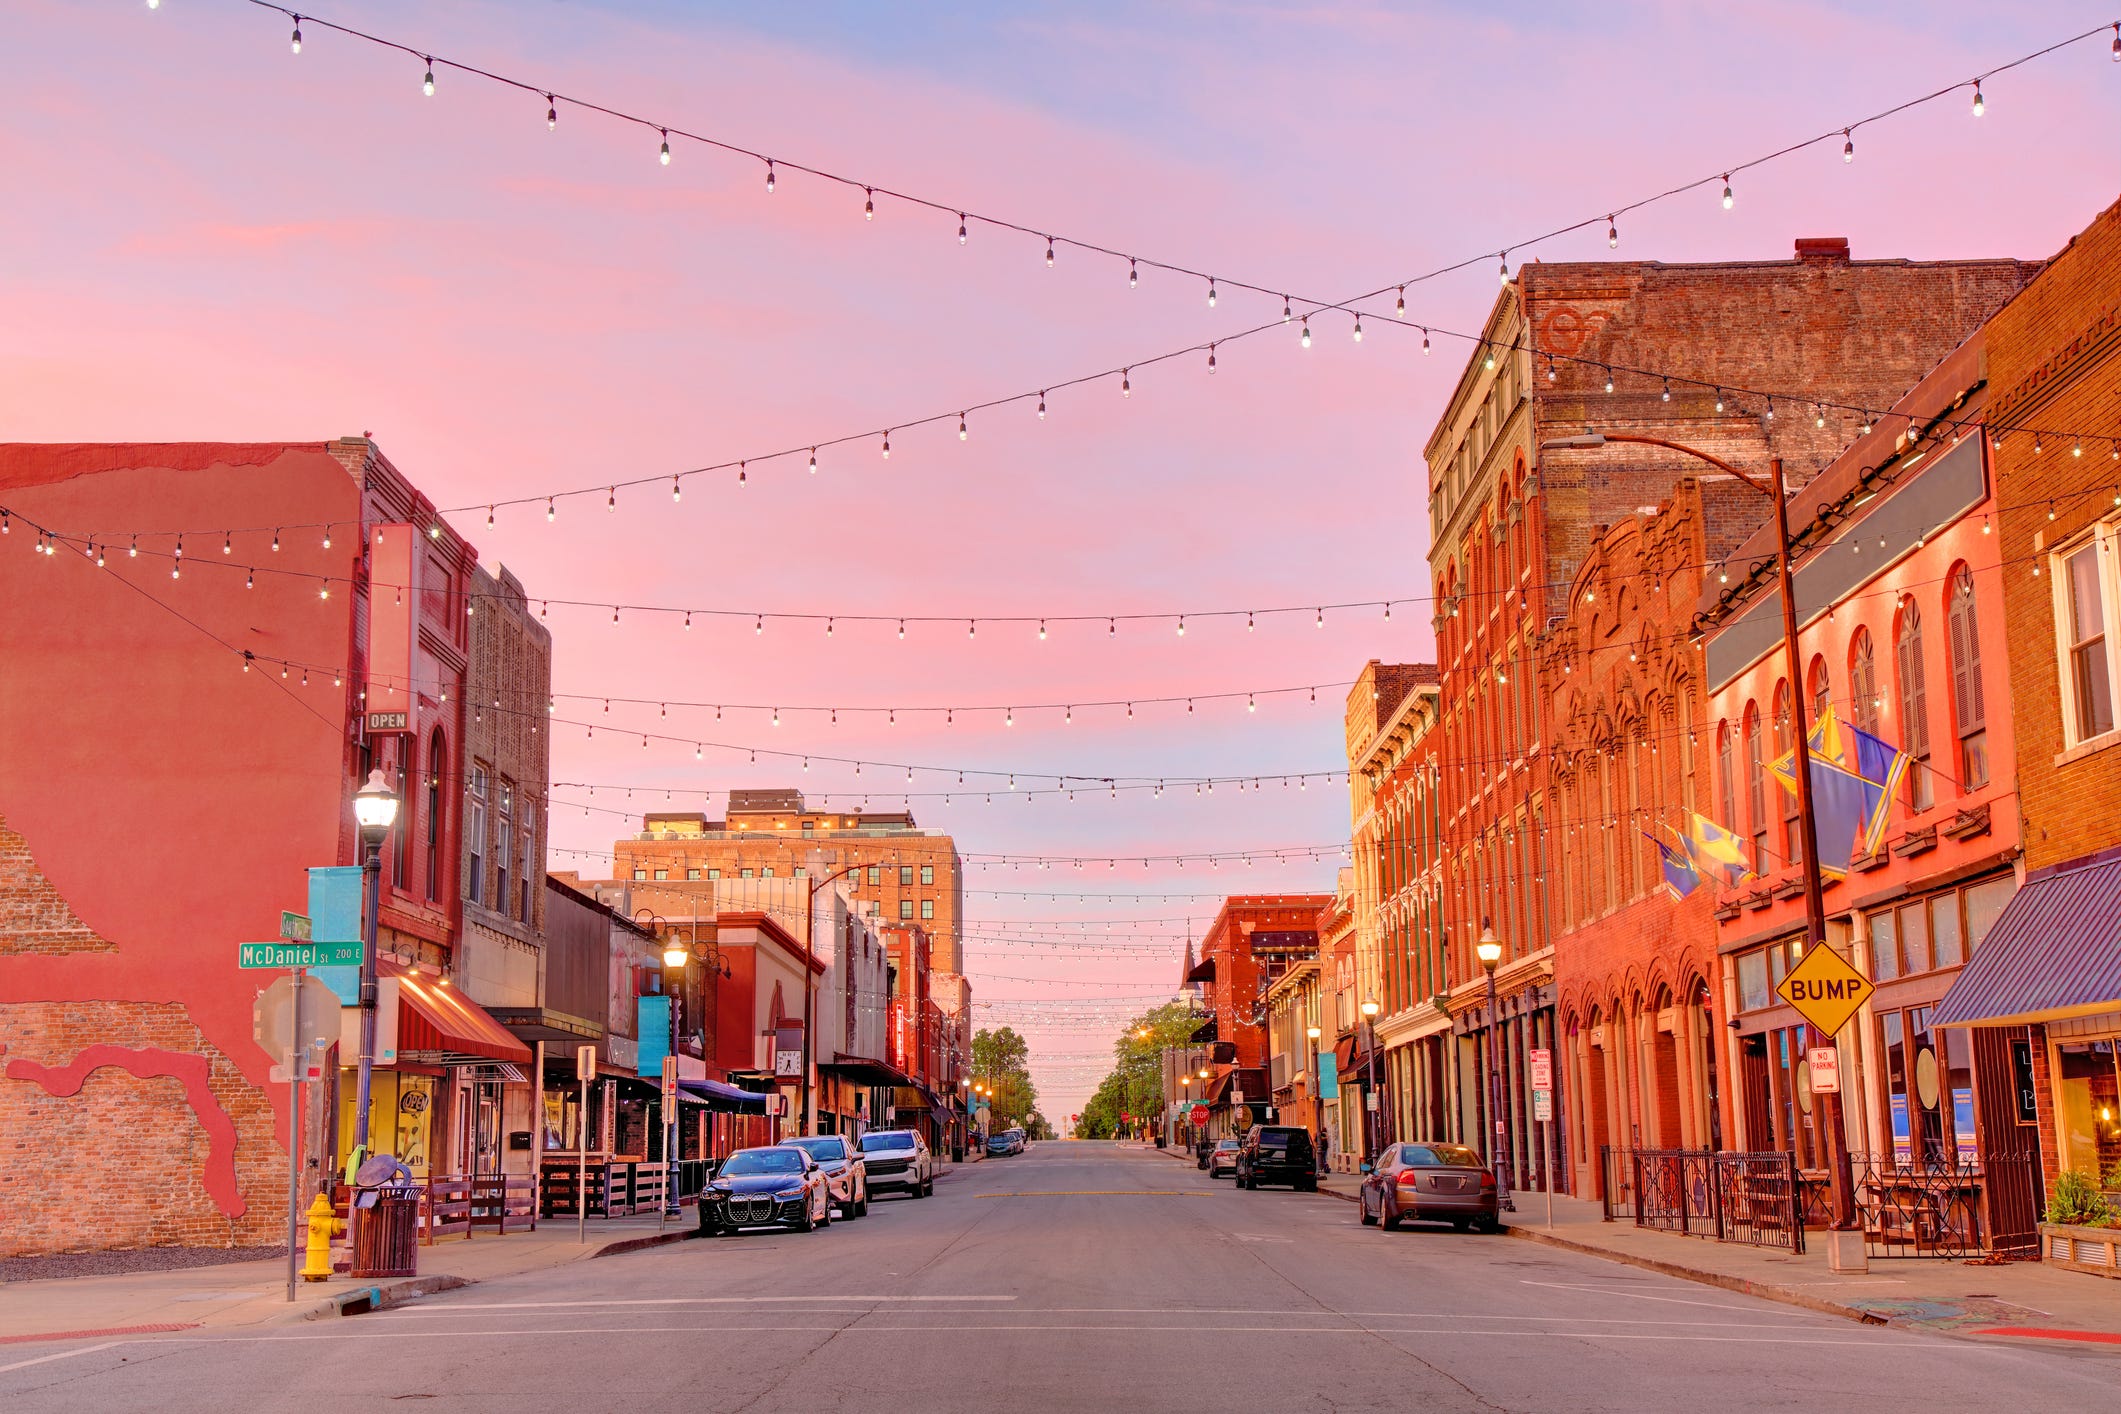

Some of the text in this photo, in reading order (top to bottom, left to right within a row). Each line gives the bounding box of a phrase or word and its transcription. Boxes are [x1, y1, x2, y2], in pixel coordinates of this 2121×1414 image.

[370, 714, 405, 728] OPEN
[243, 946, 360, 965] McDaniel St 200 E
[1790, 979, 1862, 1001] BUMP
[1817, 1052, 1828, 1061] NO
[1812, 1062, 1836, 1070] PARKING
[404, 1094, 428, 1110] OPEN
[1192, 1111, 1209, 1119] STOP
